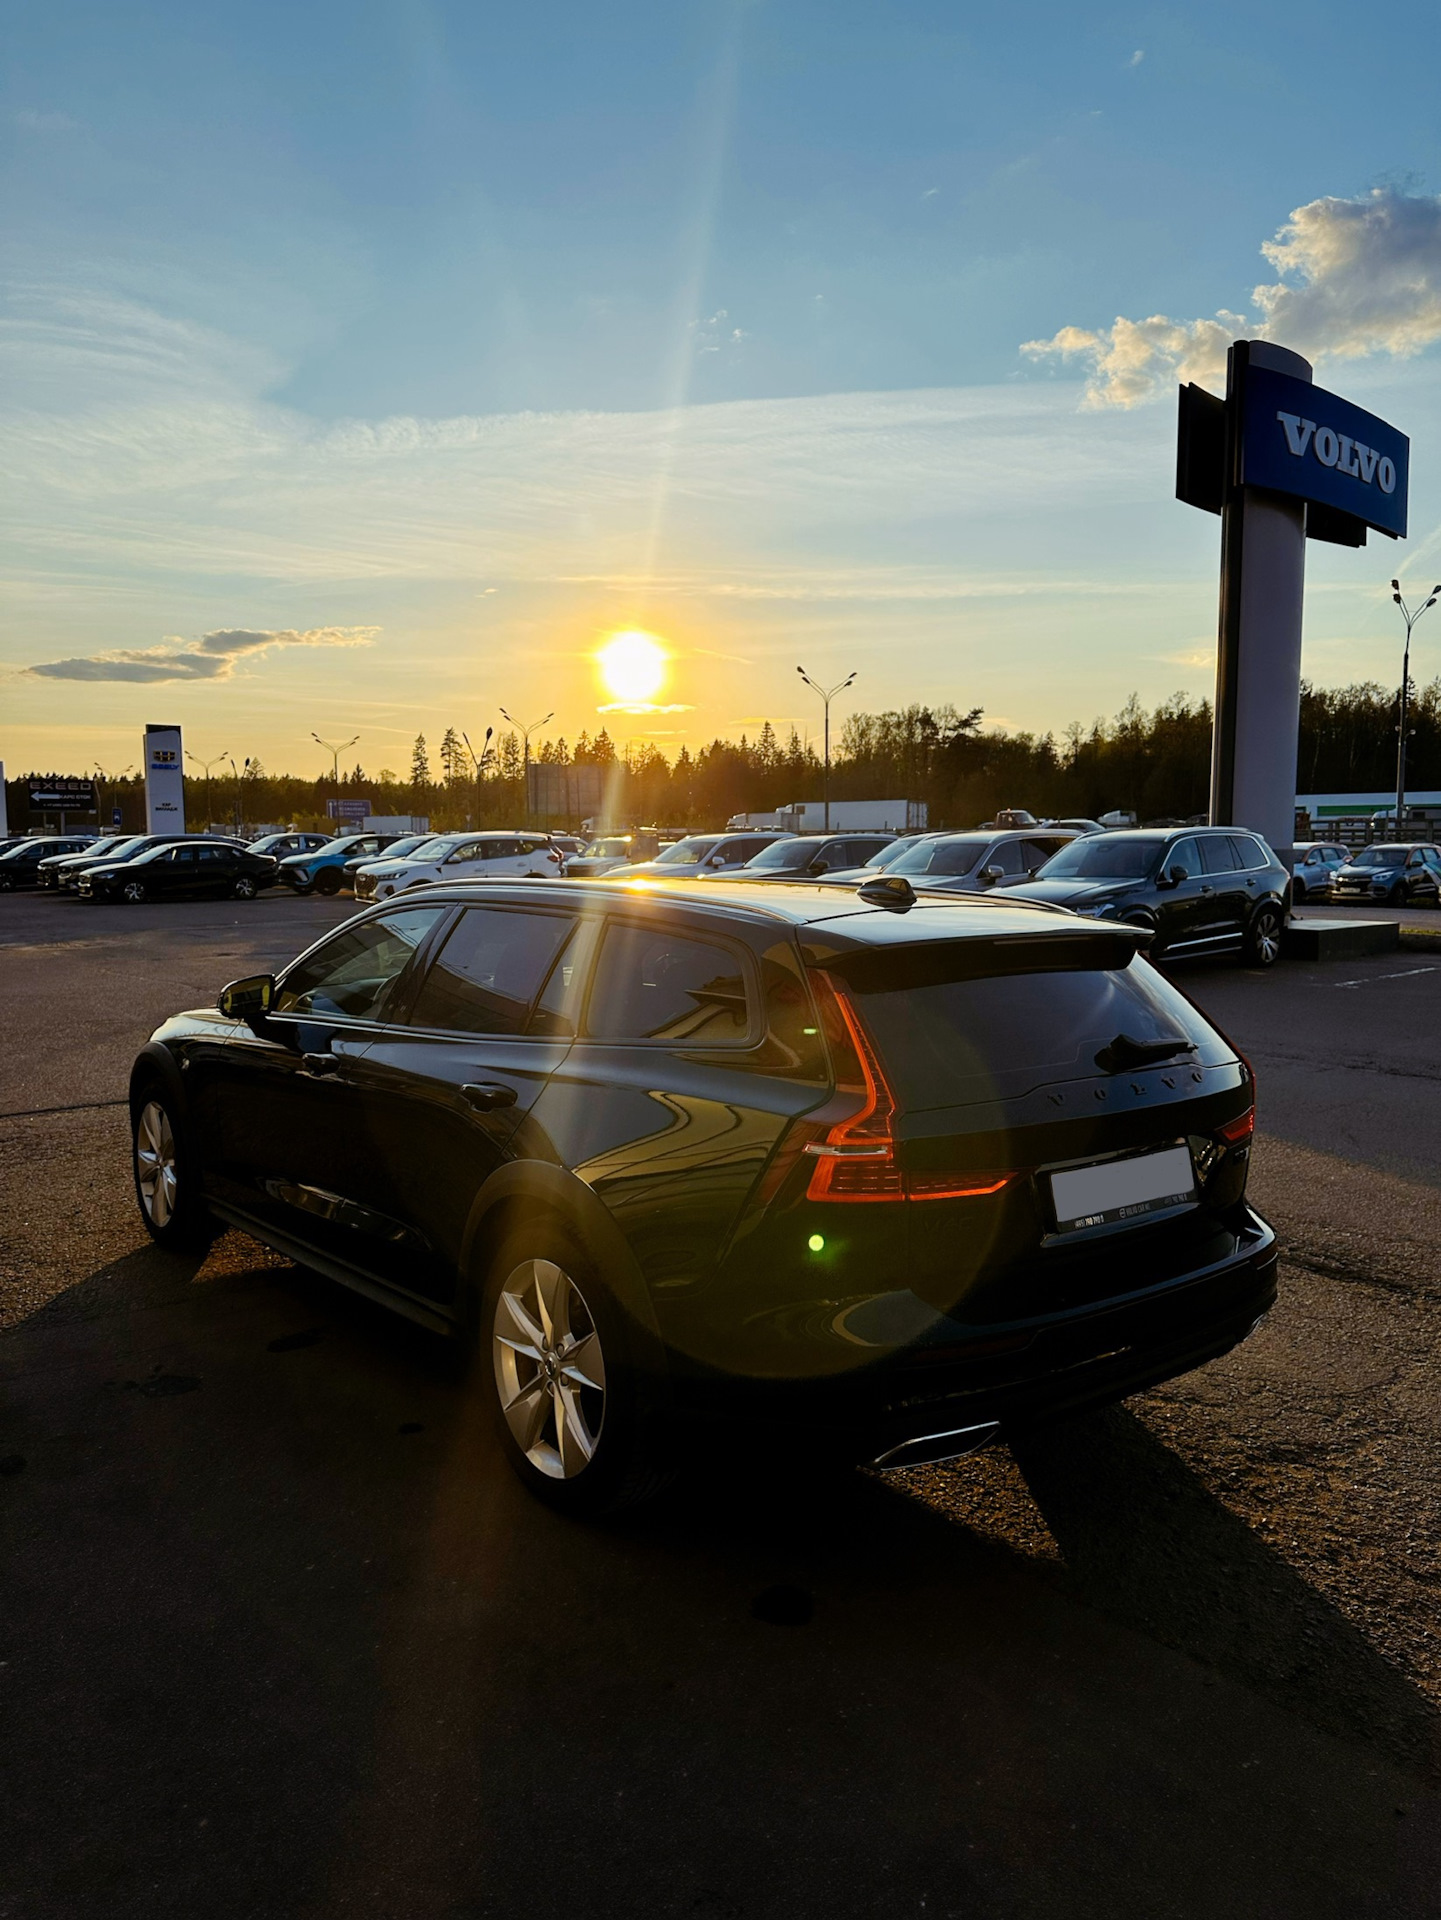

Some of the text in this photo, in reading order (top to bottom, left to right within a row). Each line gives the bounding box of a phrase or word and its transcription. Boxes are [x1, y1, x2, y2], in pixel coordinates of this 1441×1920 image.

[1276, 410, 1397, 494] VOLVO
[29, 782, 91, 790] EXEED
[1046, 1071, 1203, 1107] VOLVO
